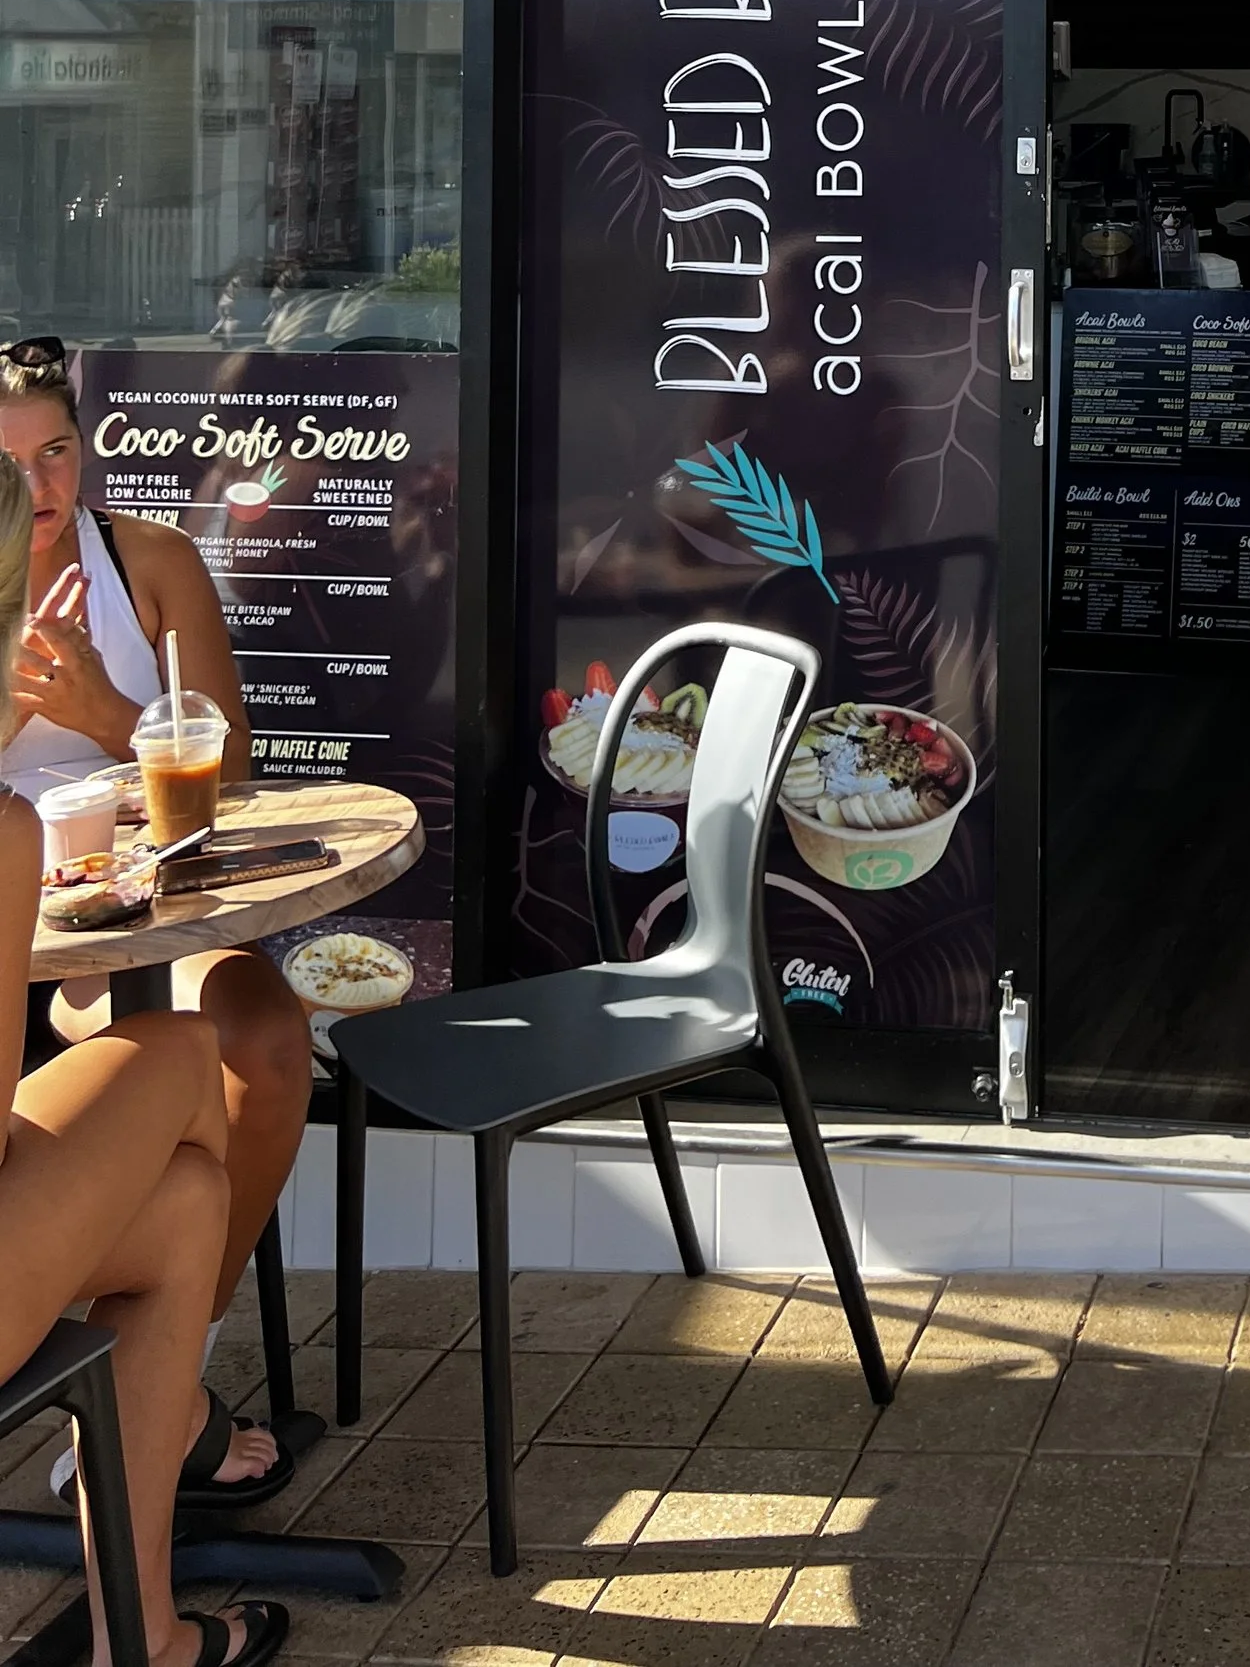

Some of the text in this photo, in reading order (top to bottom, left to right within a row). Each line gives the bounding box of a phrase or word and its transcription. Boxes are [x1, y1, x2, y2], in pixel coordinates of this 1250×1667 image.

[654, 53, 772, 394] BLESSED
[812, 234, 863, 396] acai
[1075, 311, 1146, 329] Acai Bowls
[1193, 315, 1221, 330] Coco
[1223, 316, 1250, 333] Soft
[108, 391, 151, 404] VEGAN
[154, 392, 217, 405] COCONUT
[219, 393, 264, 406] WATER
[266, 394, 300, 406] SOFT
[303, 395, 344, 407] SERVE
[94, 411, 411, 467] Coco Soft Serve
[106, 474, 179, 486] DAIRY FREE
[318, 478, 393, 490] NATURALLY
[106, 487, 192, 500] LOW CALORIE
[313, 492, 393, 504] SWEETENED
[1066, 485, 1151, 504] Build a Bowl
[1184, 490, 1241, 508] Add Ons
[328, 514, 390, 528] CUP/BOWL
[236, 538, 284, 549] GRANOLA,
[285, 539, 316, 549] FRESH
[1181, 532, 1197, 546] $2
[236, 549, 269, 558] HONEY
[327, 583, 389, 597] CUP/BOWL
[238, 606, 265, 615] BITES
[267, 606, 292, 616] (RAW
[243, 616, 275, 626] CACAO
[1178, 614, 1213, 629] $1.50
[326, 662, 389, 676] CUP/BOWL
[250, 695, 283, 706] SAUCE,
[285, 696, 316, 705] VEGAN
[270, 740, 317, 760] WAFFLE
[318, 741, 351, 761] CONE
[263, 763, 347, 776] SAUCE INCLUDED:
[782, 958, 850, 996] Gluten
